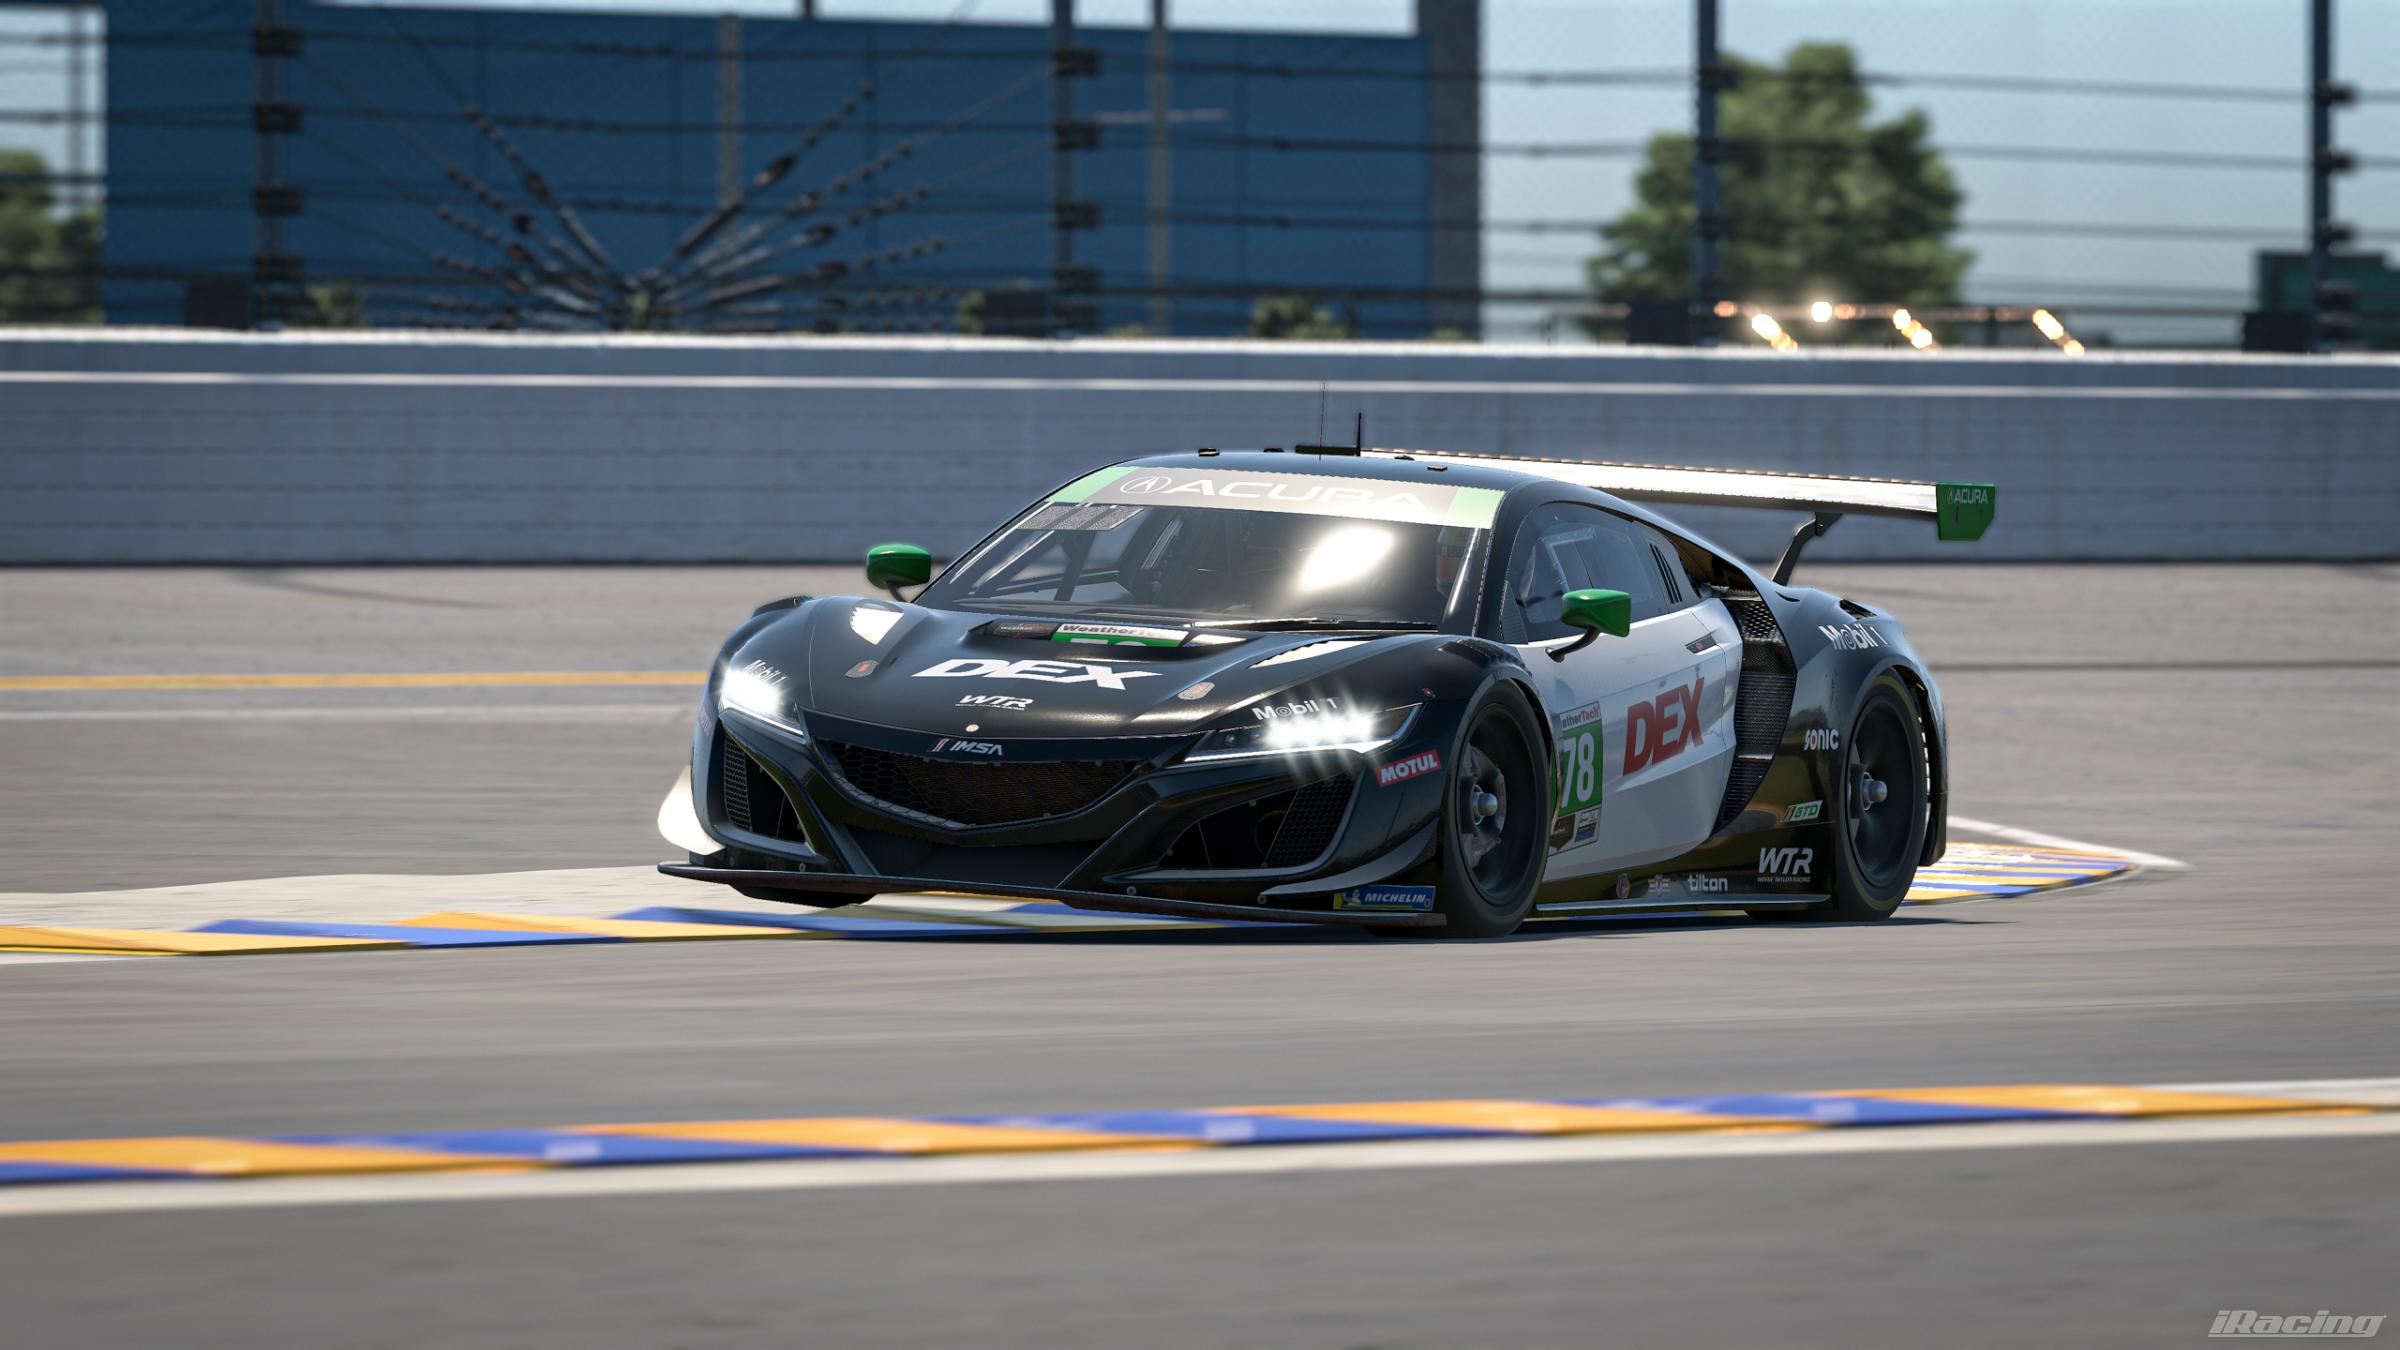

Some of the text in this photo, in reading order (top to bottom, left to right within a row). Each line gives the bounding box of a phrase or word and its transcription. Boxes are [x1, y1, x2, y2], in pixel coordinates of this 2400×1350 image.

[1167, 480, 1426, 511] ACURA
[1953, 488, 1989, 504] ACURA
[1818, 624, 1888, 650] Mobil 1
[912, 659, 1163, 690] DEX
[959, 695, 1034, 708] WTR
[1252, 700, 1319, 720] Mobil
[1562, 706, 1601, 728] atherTech
[1623, 677, 1705, 776] DEX
[950, 740, 1004, 756] IMSA
[1381, 754, 1438, 784] MOTUL
[1560, 732, 1595, 808] 78
[1795, 803, 1819, 819] GTD
[1758, 847, 1814, 874] WTR
[1687, 874, 1728, 892] tilton
[1364, 893, 1426, 904] MICHELIN
